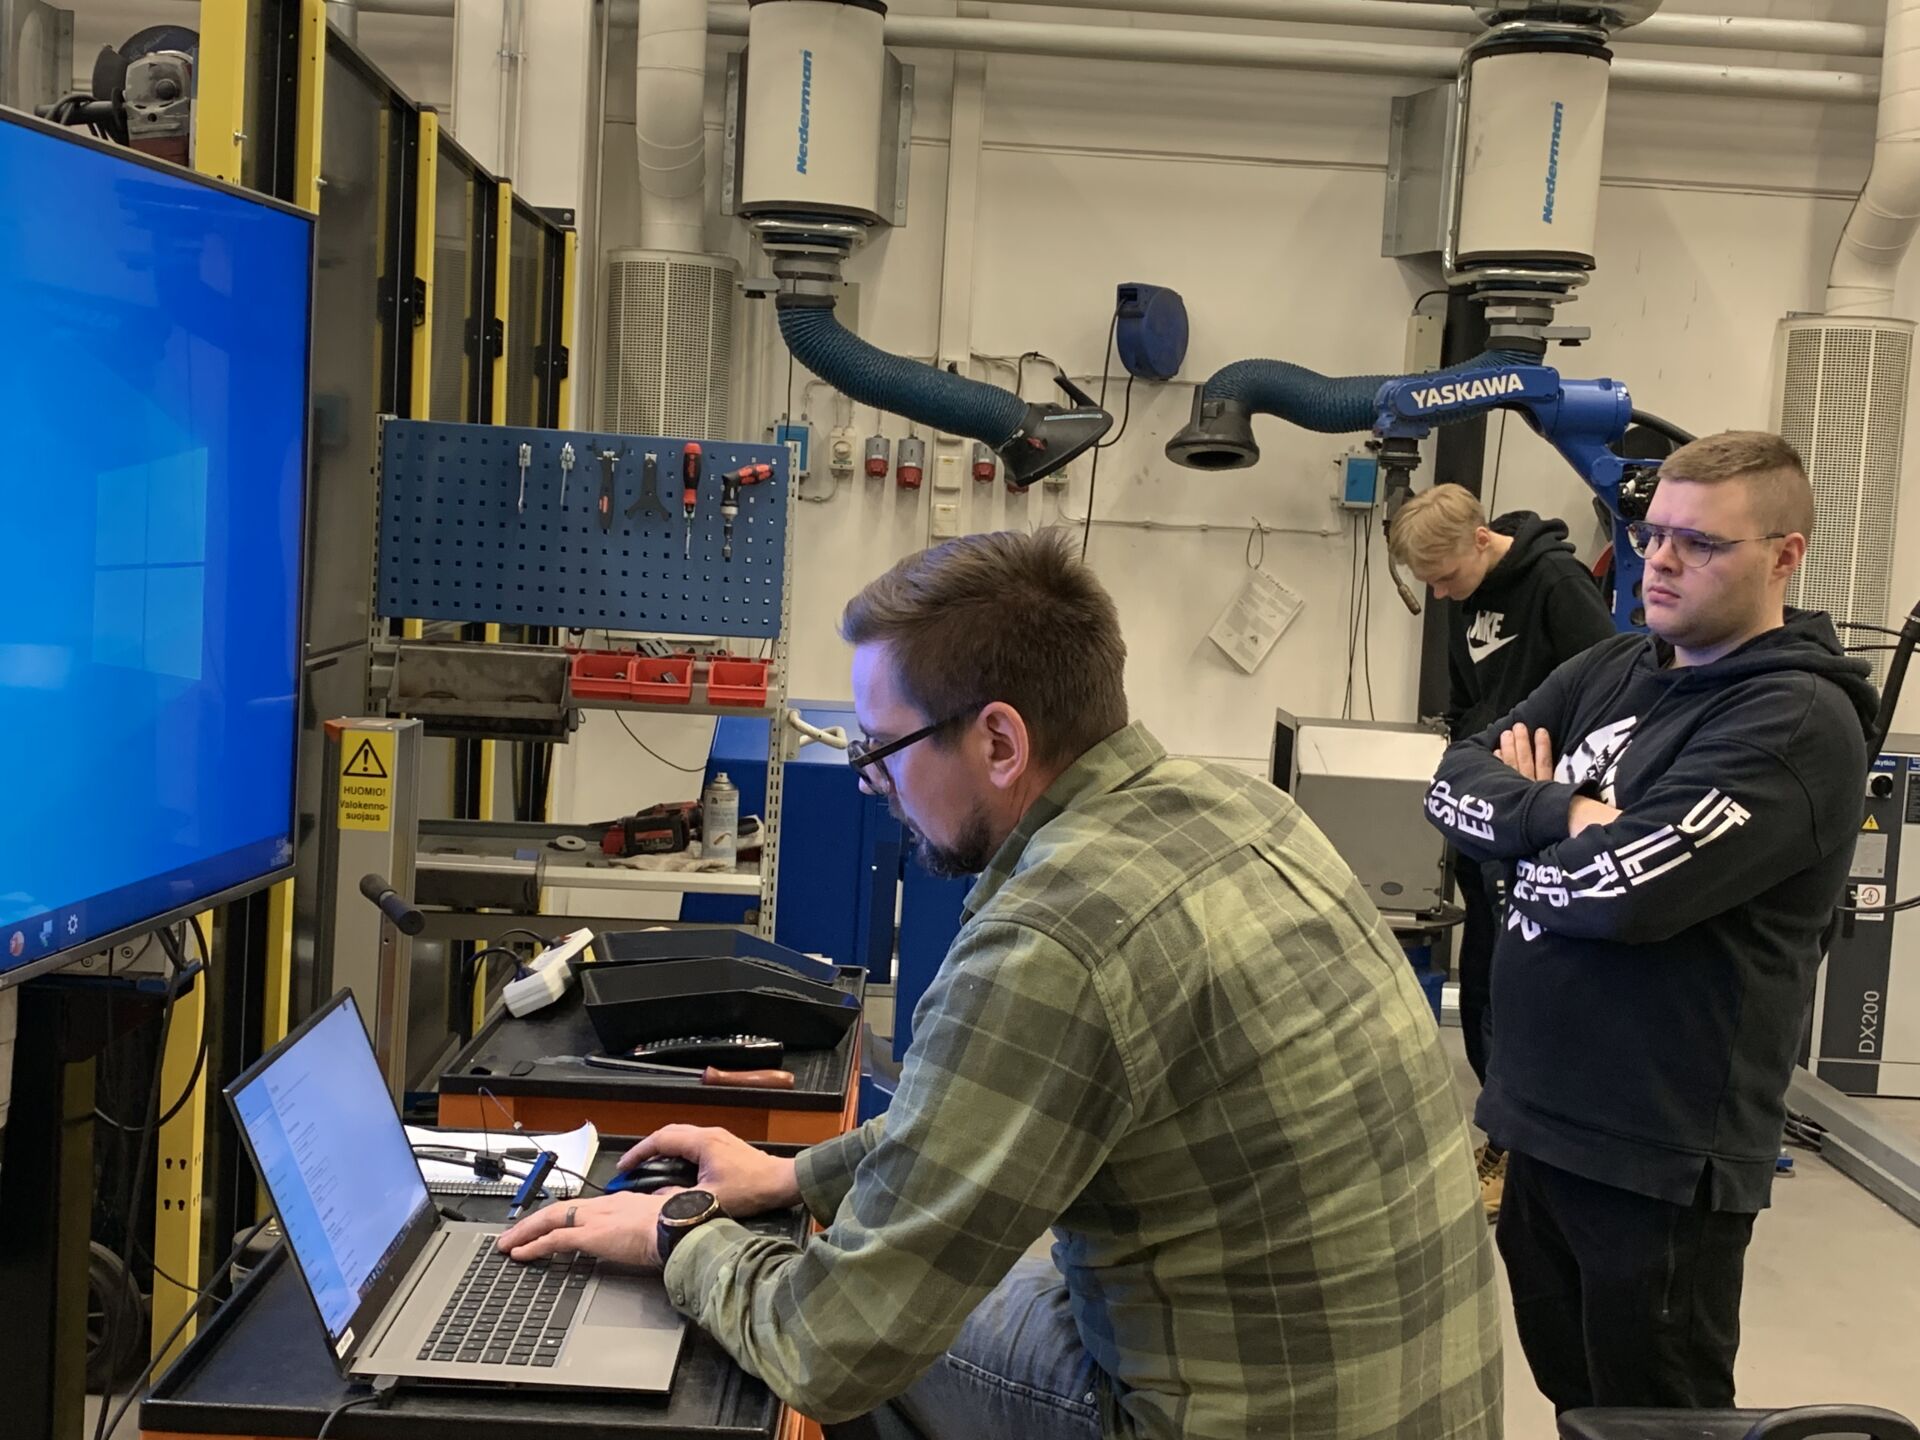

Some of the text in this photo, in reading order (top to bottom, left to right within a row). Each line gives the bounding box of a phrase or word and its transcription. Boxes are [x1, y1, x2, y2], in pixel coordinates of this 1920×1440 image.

[797, 50, 812, 175] Nederman
[1542, 101, 1564, 224] Nederman
[1411, 373, 1524, 409] YASKAWA
[340, 800, 388, 810] Valokenno-
[343, 786, 386, 797] HUOMIO!
[345, 811, 380, 822] suojaus
[1858, 990, 1880, 1053] DX200
